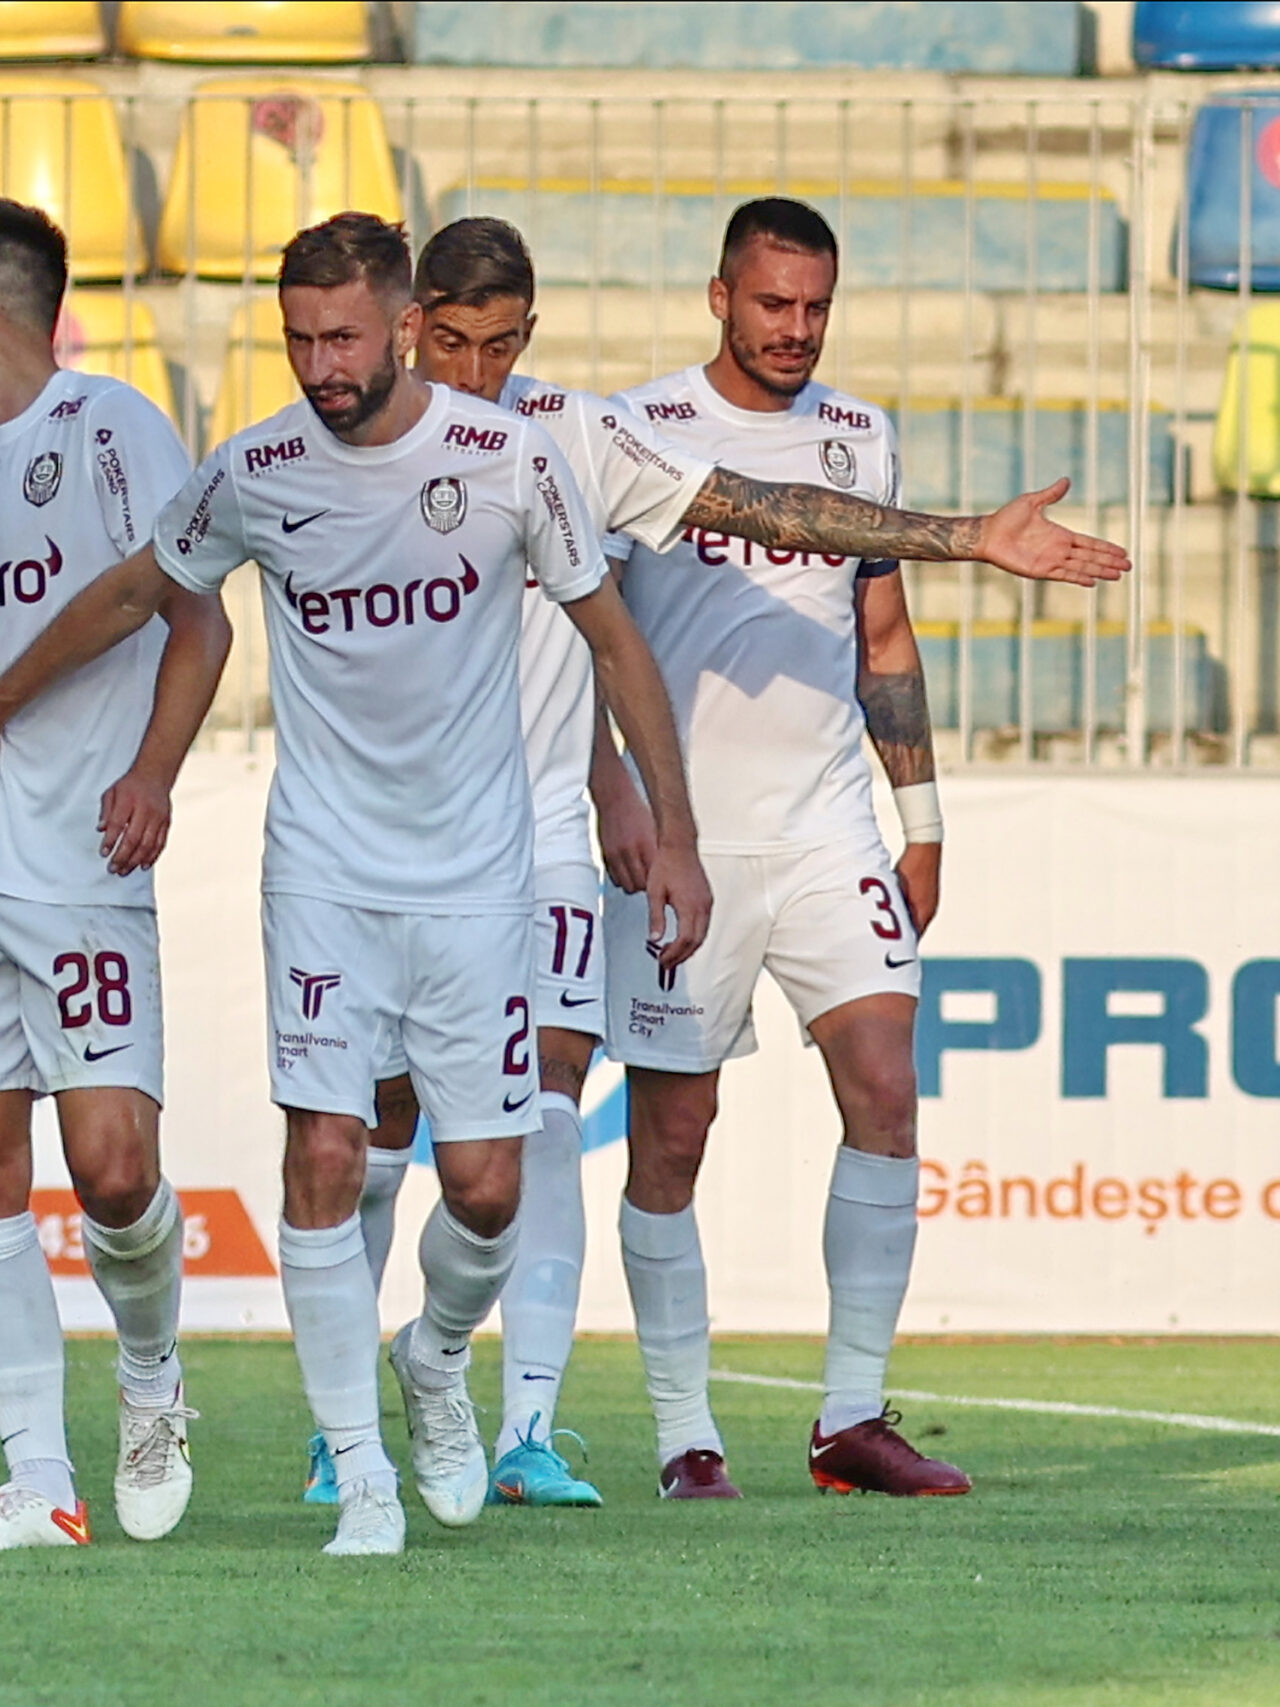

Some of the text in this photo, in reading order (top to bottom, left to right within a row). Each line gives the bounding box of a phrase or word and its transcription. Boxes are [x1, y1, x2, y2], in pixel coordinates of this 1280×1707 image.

[645, 402, 696, 421] RMB
[818, 402, 871, 429] RMB
[443, 424, 508, 451] RMB
[244, 436, 306, 473] RMB
[105, 448, 135, 542] POKERSTARS
[545, 474, 582, 567] POKERSTARS
[859, 877, 902, 940] 3
[549, 906, 594, 979] 17
[54, 951, 132, 1028] 28
[629, 1010, 665, 1026] Smart
[631, 998, 704, 1016] Transilvania
[502, 995, 531, 1076] 2
[628, 1022, 652, 1038] City
[278, 1046, 308, 1058] mart
